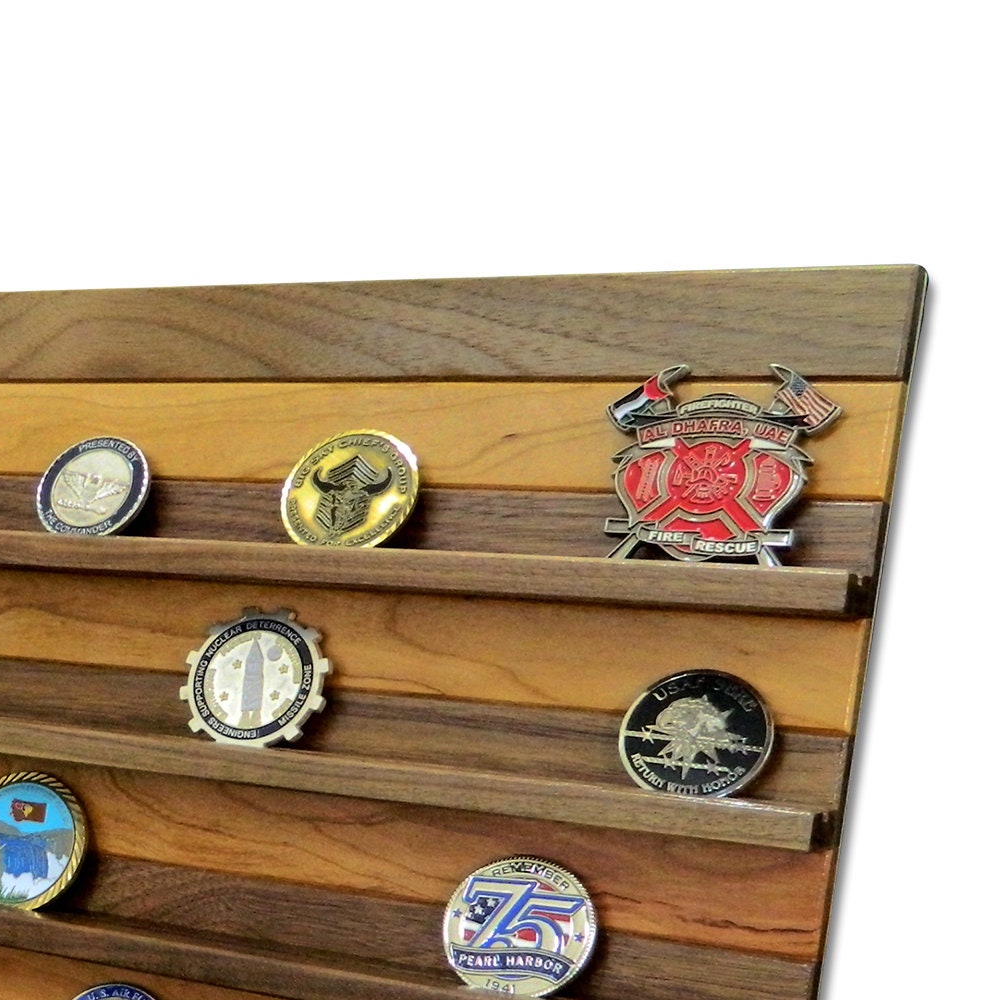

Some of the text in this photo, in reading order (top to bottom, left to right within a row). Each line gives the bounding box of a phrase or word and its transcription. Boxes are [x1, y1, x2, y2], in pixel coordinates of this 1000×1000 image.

[679, 398, 758, 415] FIREFIGHTER
[642, 419, 790, 442] AL DHAFRA, UAE
[79, 440, 139, 462] PRESENTED BY
[338, 438, 390, 452] CHIEF'S
[391, 452, 408, 495] GROUP
[44, 509, 113, 535] THE COMMANDER
[648, 531, 757, 554] FIRE RESCUE
[195, 620, 301, 738] ENGINEERS SUPPORTING NUCLEAR DETERRENCE
[278, 664, 312, 727] MISSILE ZONE
[631, 753, 747, 794] RETURN WITH HONOR
[492, 862, 570, 890] REMEMBER
[462, 876, 587, 955] 75
[458, 954, 563, 974] PEARL HARBOR
[112, 988, 130, 999] AIR
[486, 979, 516, 994] 1941
